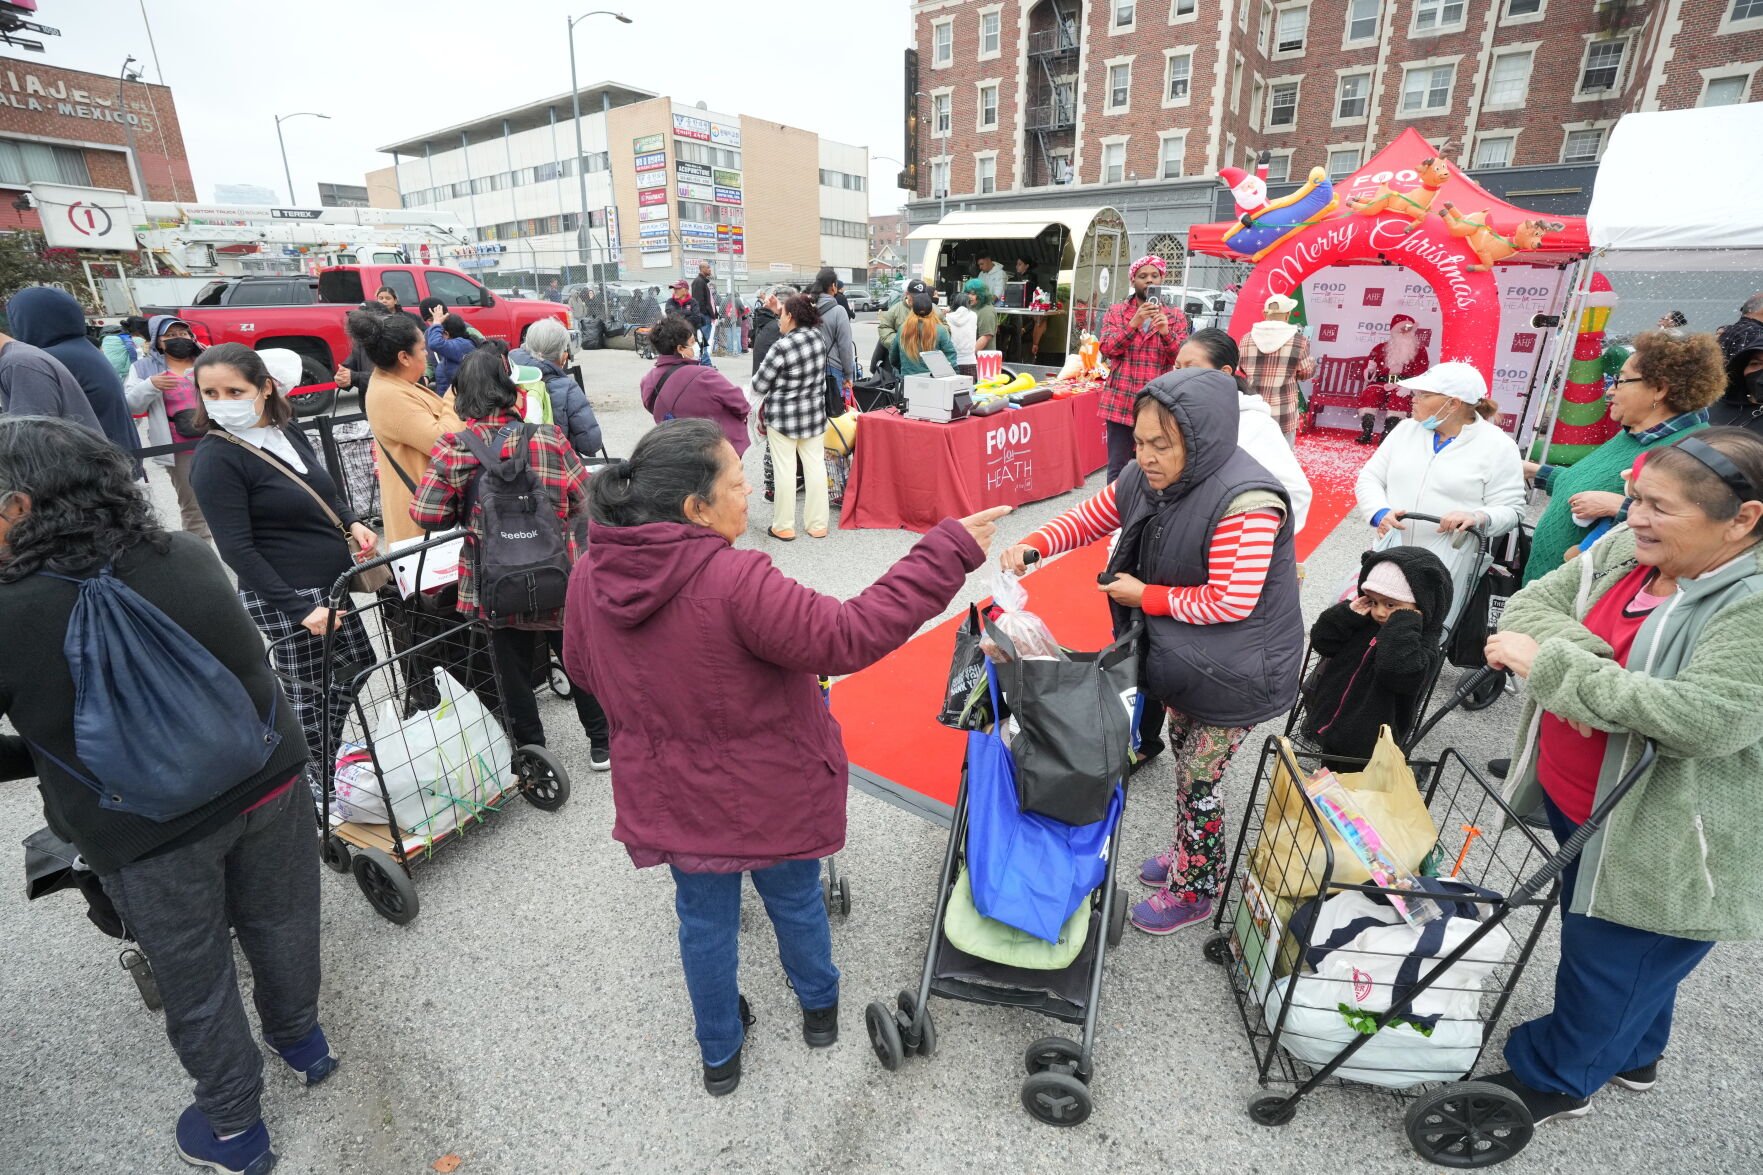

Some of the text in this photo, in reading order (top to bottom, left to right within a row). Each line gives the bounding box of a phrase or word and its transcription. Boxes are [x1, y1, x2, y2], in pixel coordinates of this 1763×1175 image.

[0, 70, 111, 107] IAJE
[57, 102, 139, 126] MEXICO
[1352, 169, 1425, 188] FOO
[284, 209, 312, 218] TEREX
[1267, 217, 1477, 311] Merry Christmas
[1313, 282, 1346, 292] FOOD
[1506, 286, 1549, 297] FOOD
[1366, 292, 1382, 301] AHF
[1503, 301, 1546, 311] HEALTH
[1321, 328, 1336, 337] AHF
[1516, 338, 1532, 348] AHF
[986, 421, 1031, 455] FOOD
[987, 459, 1032, 491] HEATH
[500, 529, 539, 541] Reebok
